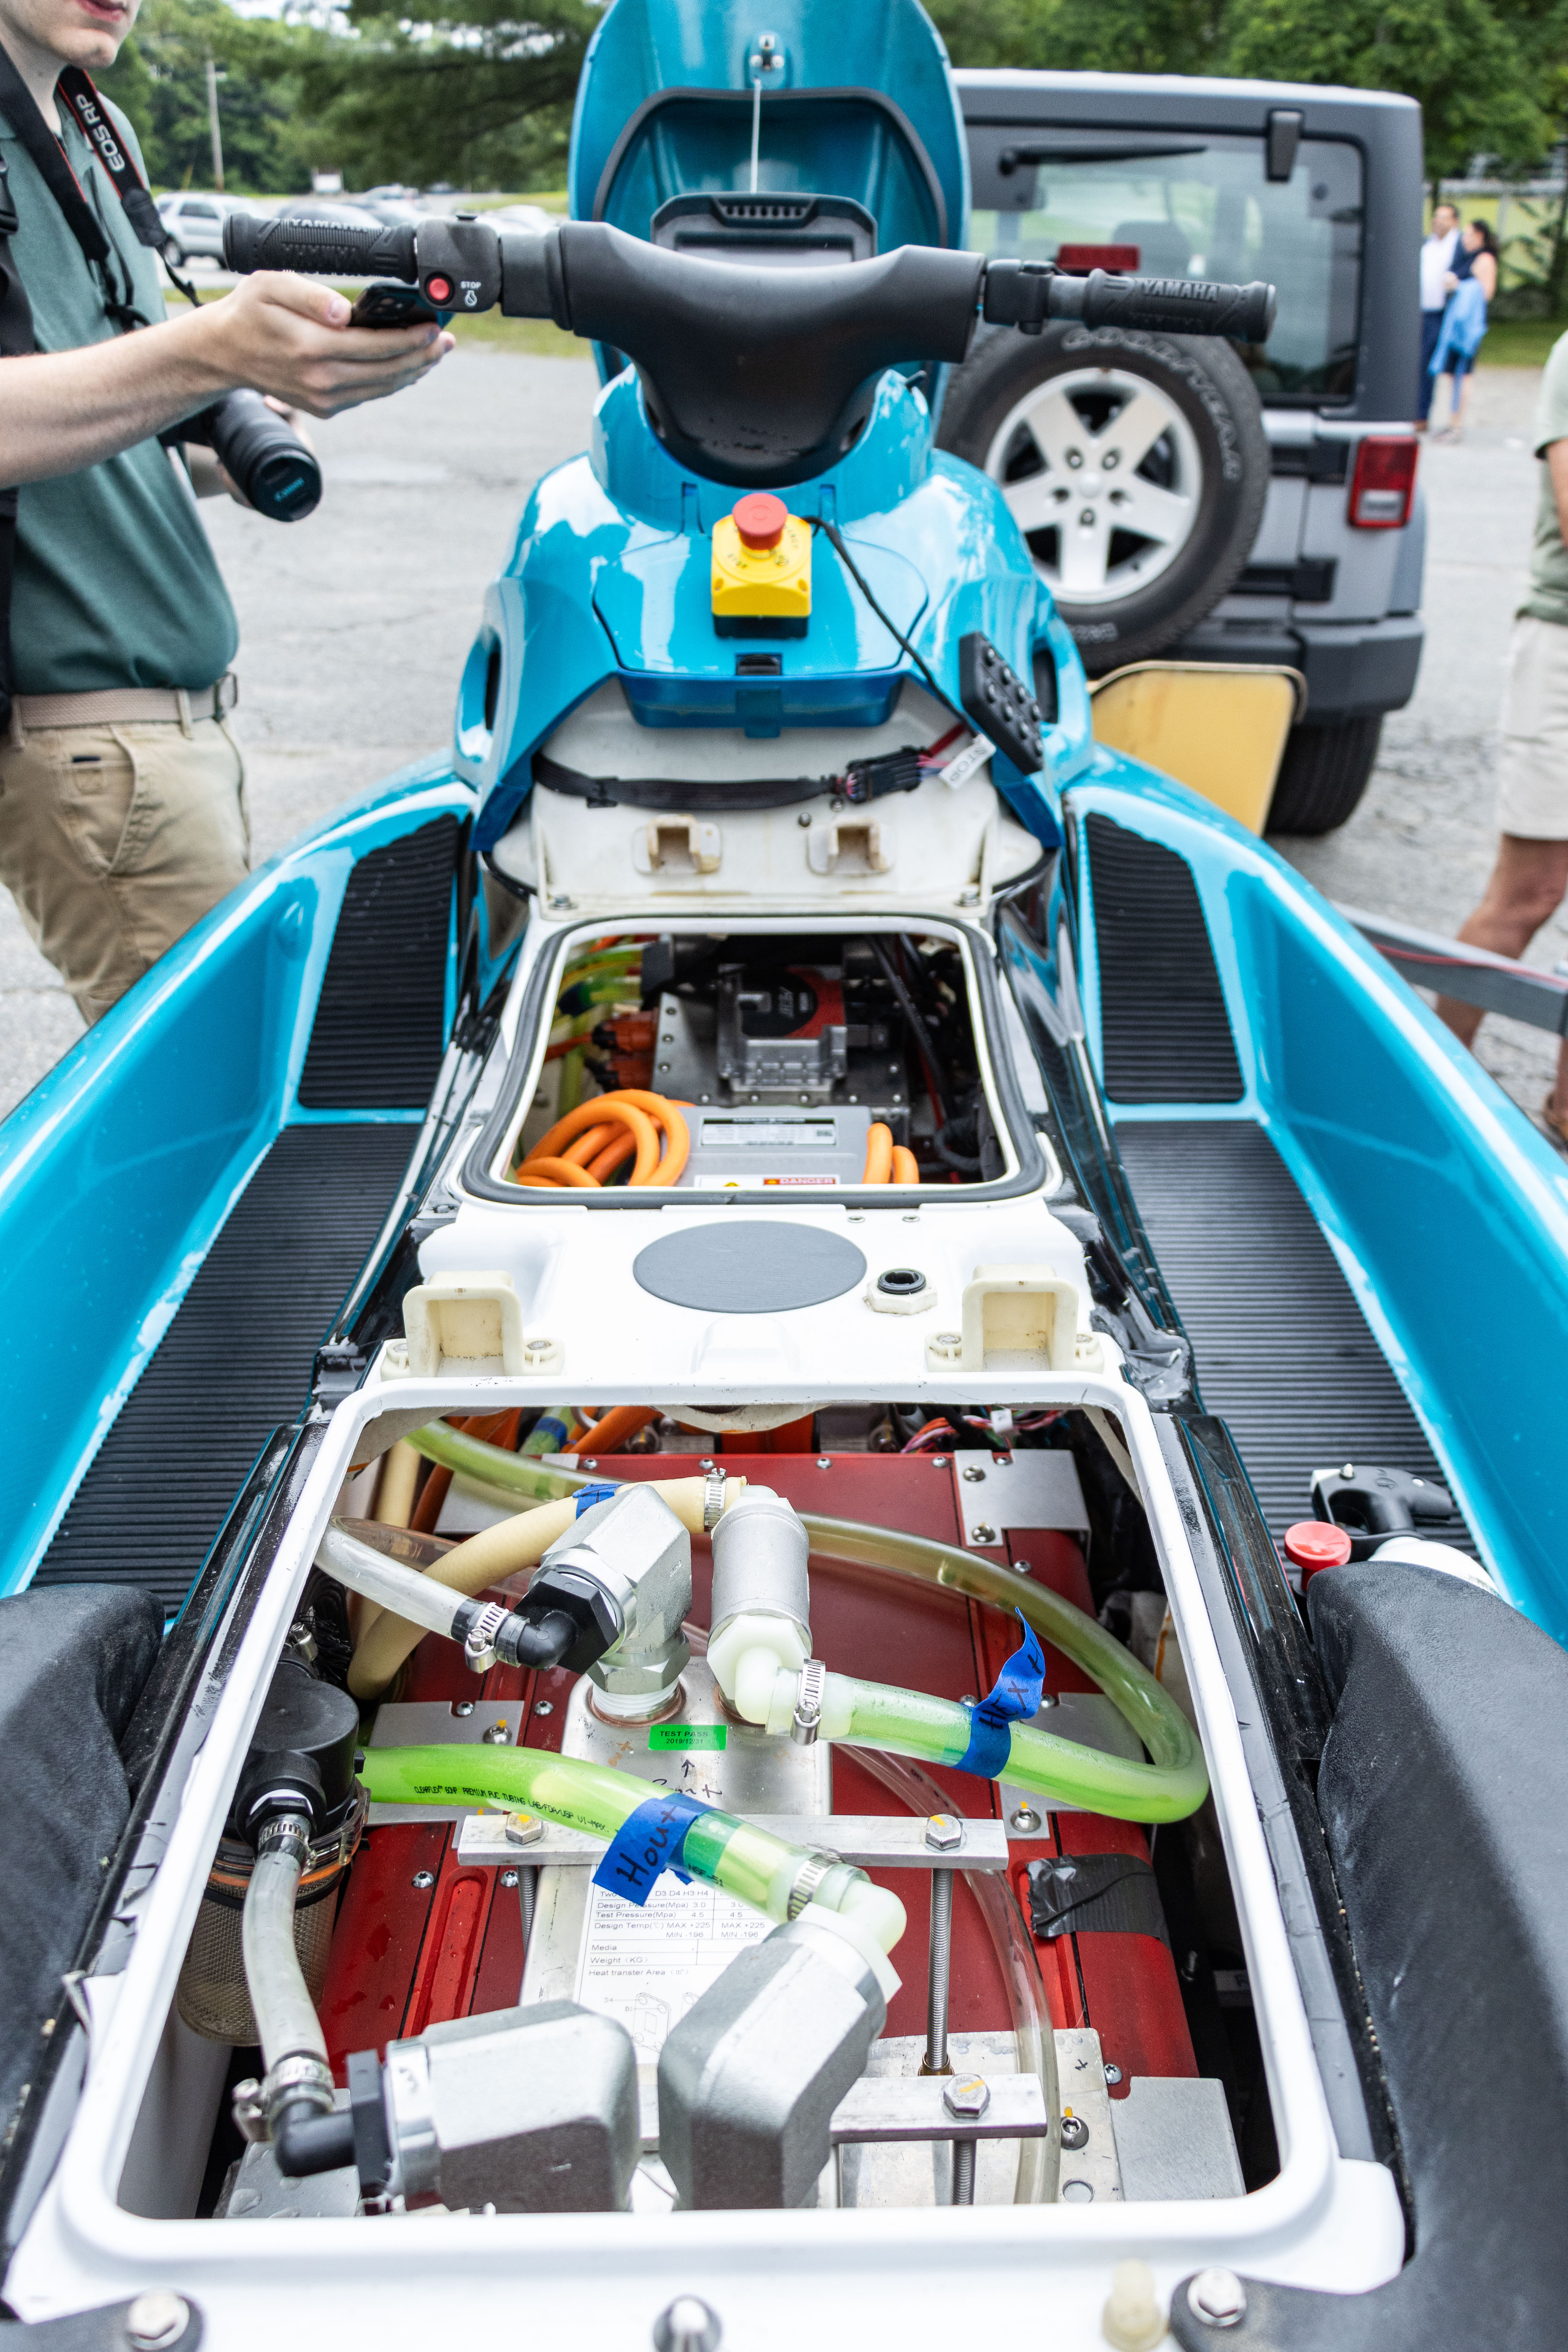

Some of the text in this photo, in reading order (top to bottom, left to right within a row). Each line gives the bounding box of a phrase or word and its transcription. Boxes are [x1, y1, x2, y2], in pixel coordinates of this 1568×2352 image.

[75, 94, 125, 172] EOS RP
[460, 281, 481, 289] STOP
[1142, 279, 1220, 300] YAMAHA
[462, 1787, 487, 1797] PREMIUM
[502, 1793, 526, 1805] TUBING
[688, 1863, 724, 1887] NSF-51
